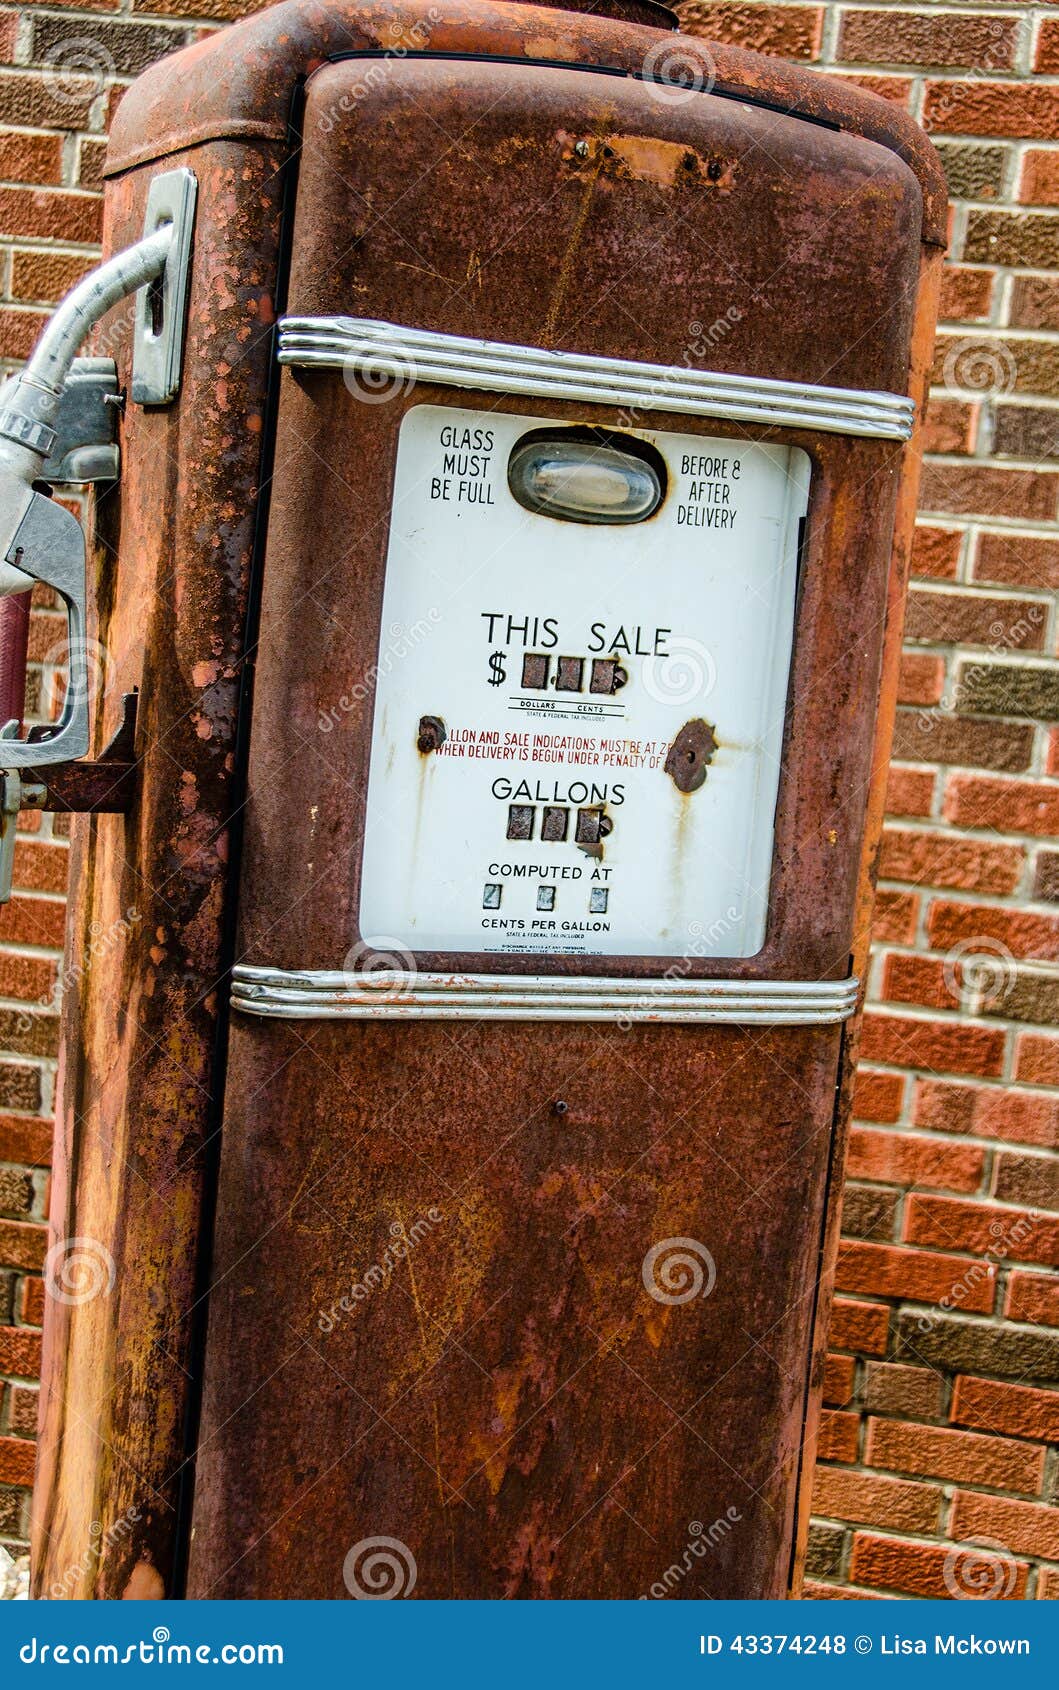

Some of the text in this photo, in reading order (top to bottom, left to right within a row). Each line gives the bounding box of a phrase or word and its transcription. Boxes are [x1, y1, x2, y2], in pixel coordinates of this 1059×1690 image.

[440, 426, 494, 452] GLASS
[443, 453, 491, 478] MUST
[681, 455, 728, 479] BEFORE
[430, 478, 495, 505] BE FULL
[688, 481, 730, 504] AFTER
[677, 505, 737, 529] DELIVERY
[481, 613, 671, 657] THIS SALE
[487, 650, 507, 687] $
[520, 701, 604, 713] DOLLARS CENTS
[447, 728, 477, 743] LLON
[479, 731, 500, 745] AND
[504, 732, 530, 747] SALE
[533, 734, 597, 751] INDICATIONS
[600, 739, 626, 753] MUST
[629, 741, 642, 754] BE
[644, 742, 656, 754] AT
[435, 743, 661, 769] WHEN DELIVERY IS BEGUN UNDER PENALTY OF
[492, 777, 625, 806] GALLONS
[488, 863, 613, 881] COMPUTED AT
[481, 918, 611, 932] CENTS PER GALLON
